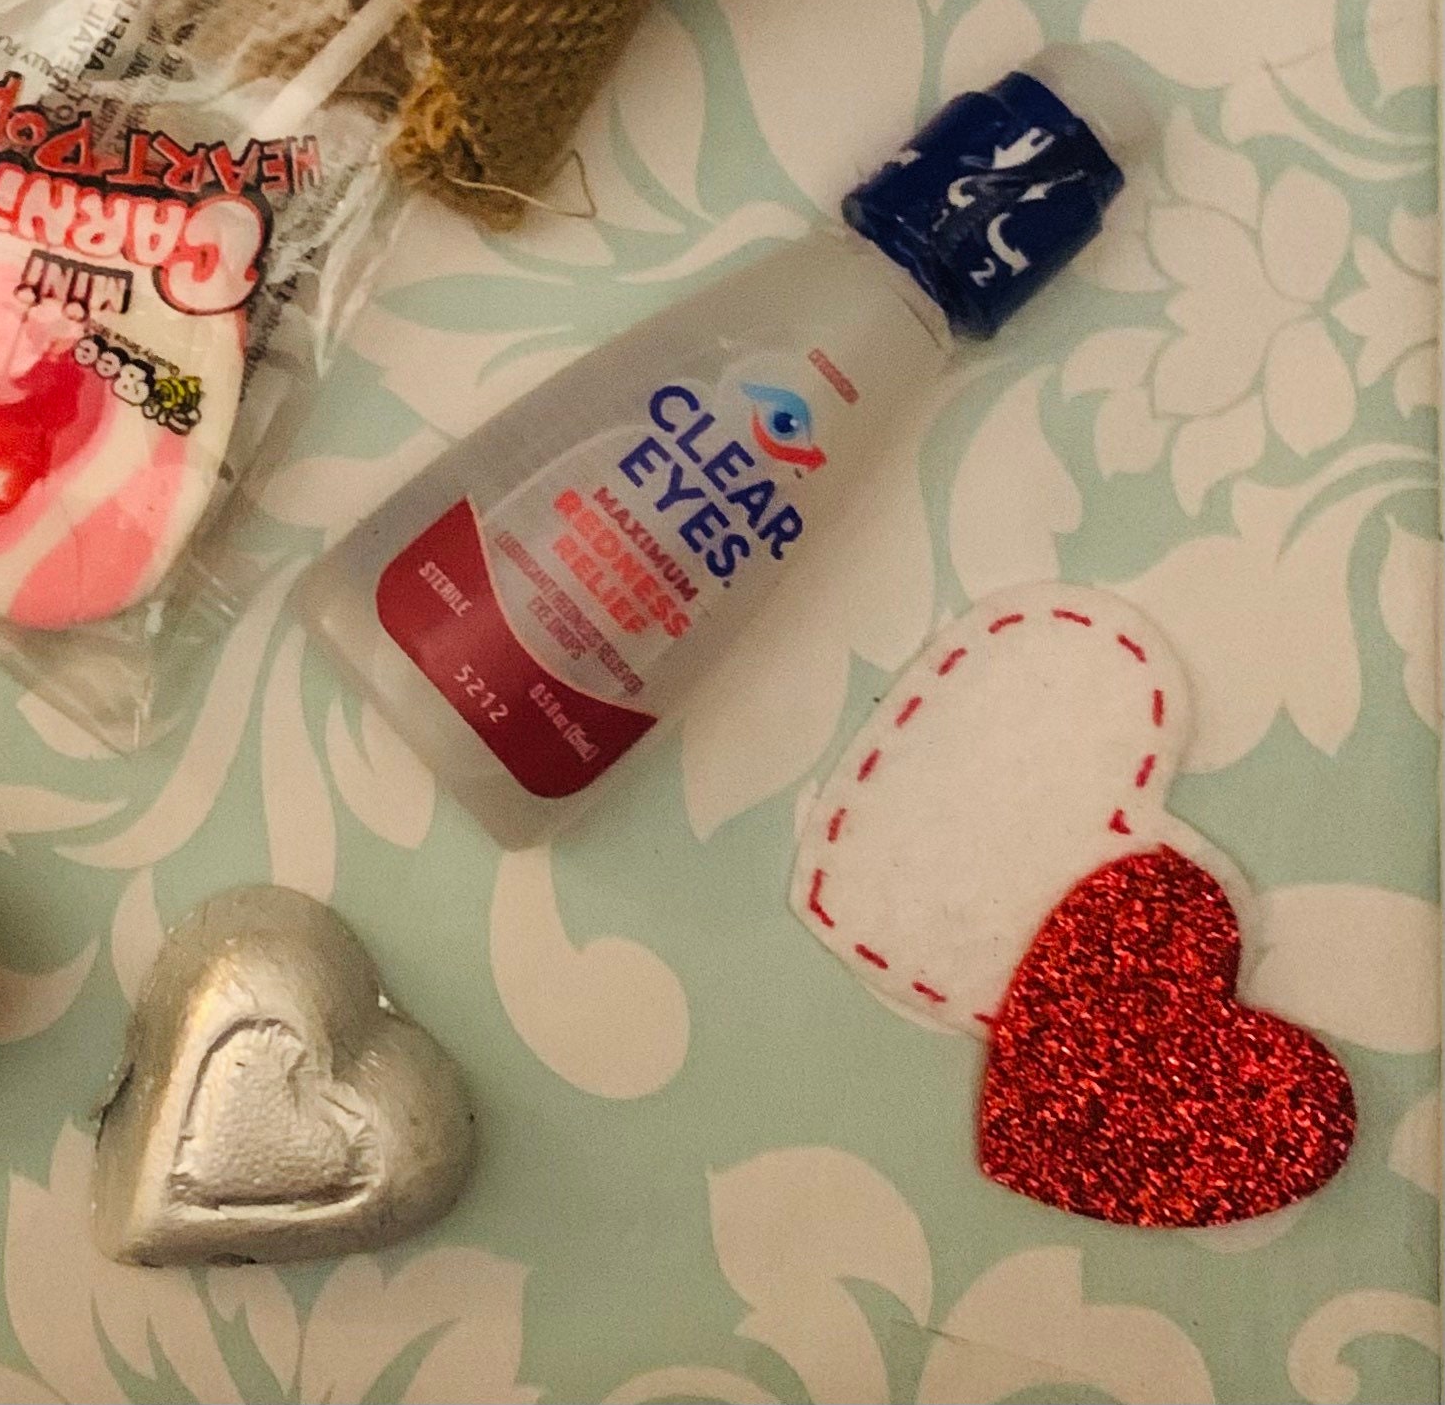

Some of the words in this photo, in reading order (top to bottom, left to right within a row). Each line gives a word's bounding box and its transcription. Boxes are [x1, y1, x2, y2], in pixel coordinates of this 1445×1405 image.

[107, 129, 322, 197] HEART
[72, 332, 158, 407] Bee
[649, 385, 803, 560] CLEAR
[553, 489, 691, 638] REDNESS
[553, 535, 648, 634] RELIEF
[593, 486, 699, 602] MAXIMUM
[416, 560, 473, 618] STERILE
[452, 663, 509, 724] 5212
